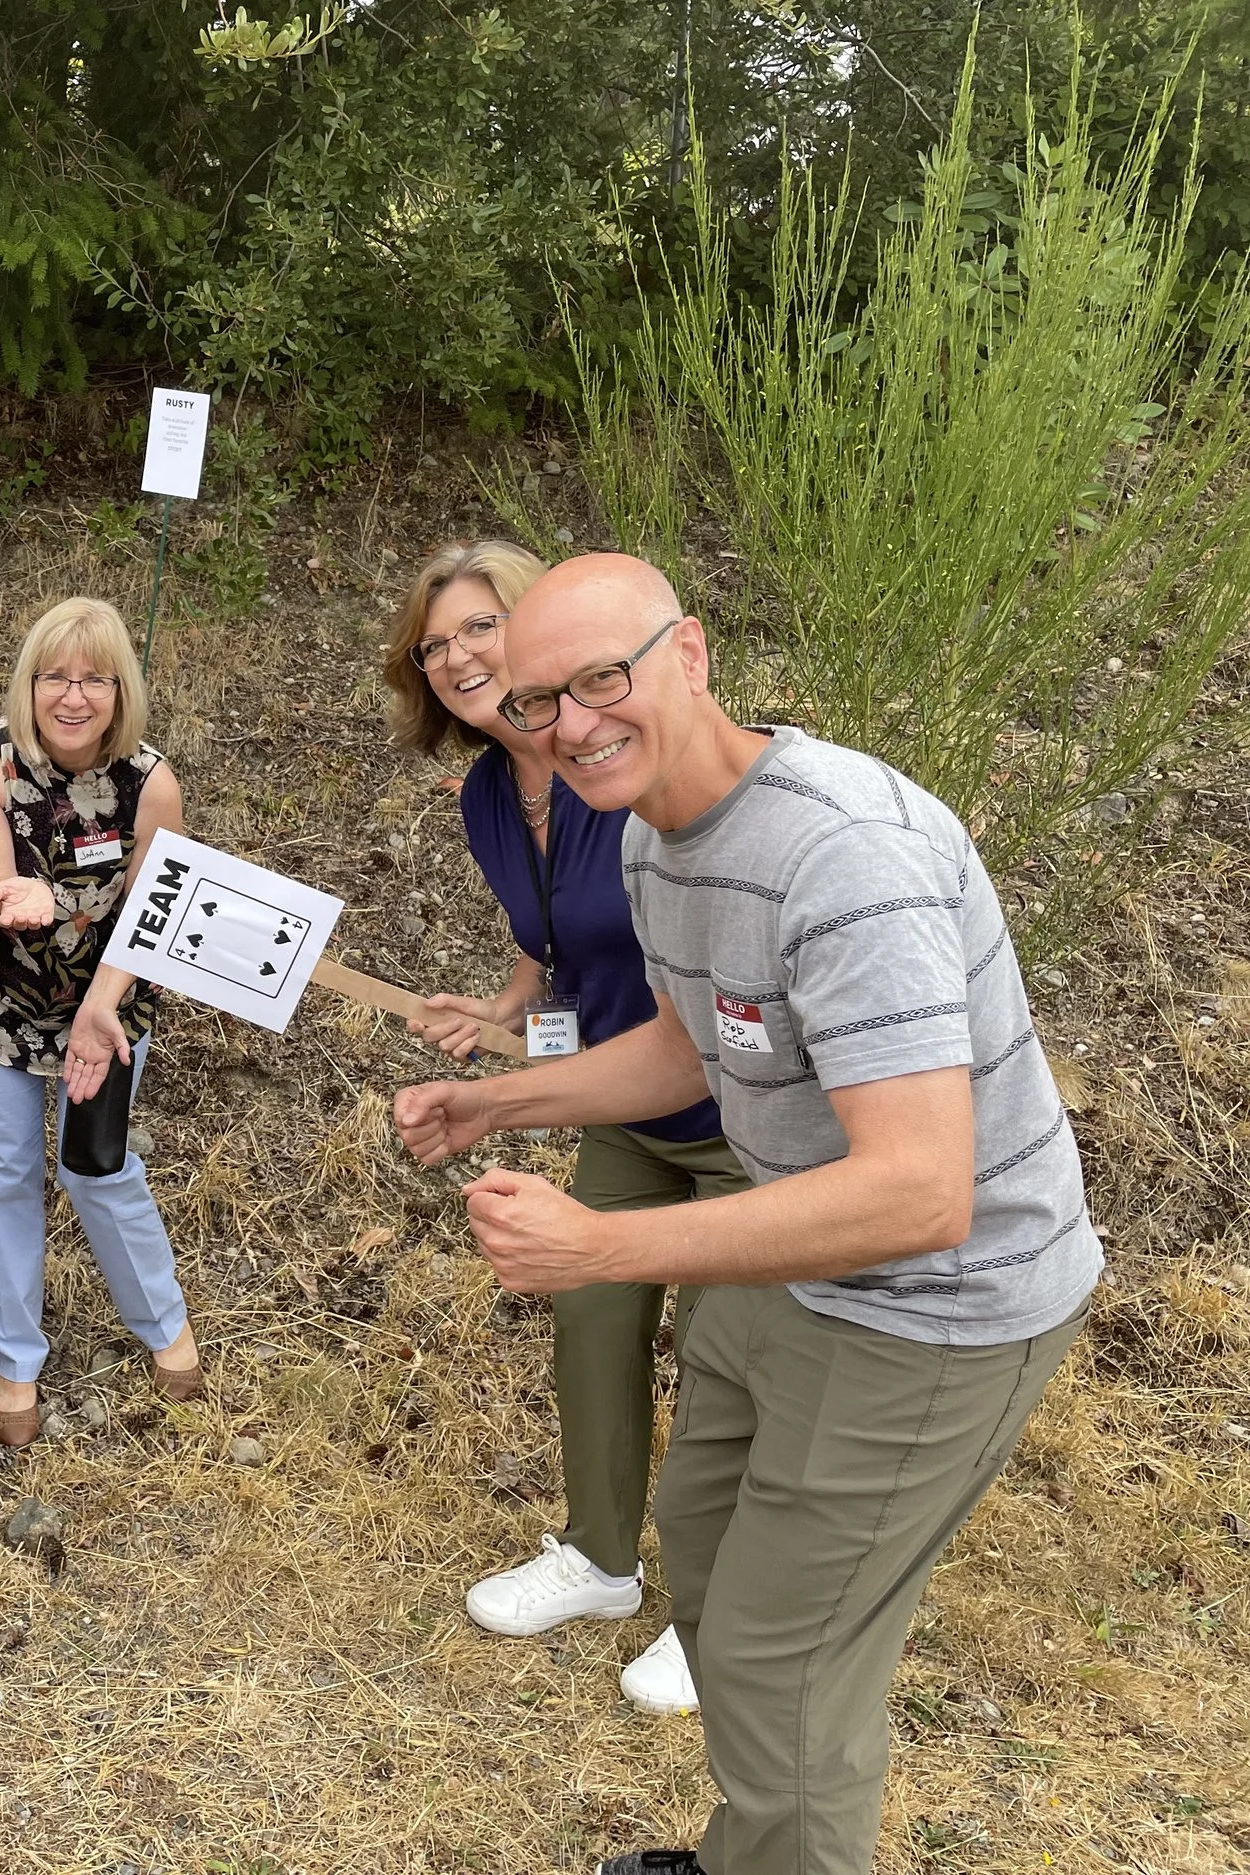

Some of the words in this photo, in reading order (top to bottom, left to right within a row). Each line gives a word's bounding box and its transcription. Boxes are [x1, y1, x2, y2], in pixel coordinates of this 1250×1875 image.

[165, 398, 195, 410] RUSTY
[84, 833, 107, 842] HELLO
[127, 857, 191, 951] TEAM
[292, 920, 304, 930] 4
[175, 947, 186, 957] 4
[721, 999, 746, 1014] HELLO
[540, 1017, 565, 1027] ROBIN
[721, 1016, 745, 1035] Rob
[538, 1031, 567, 1039] GOODWIN
